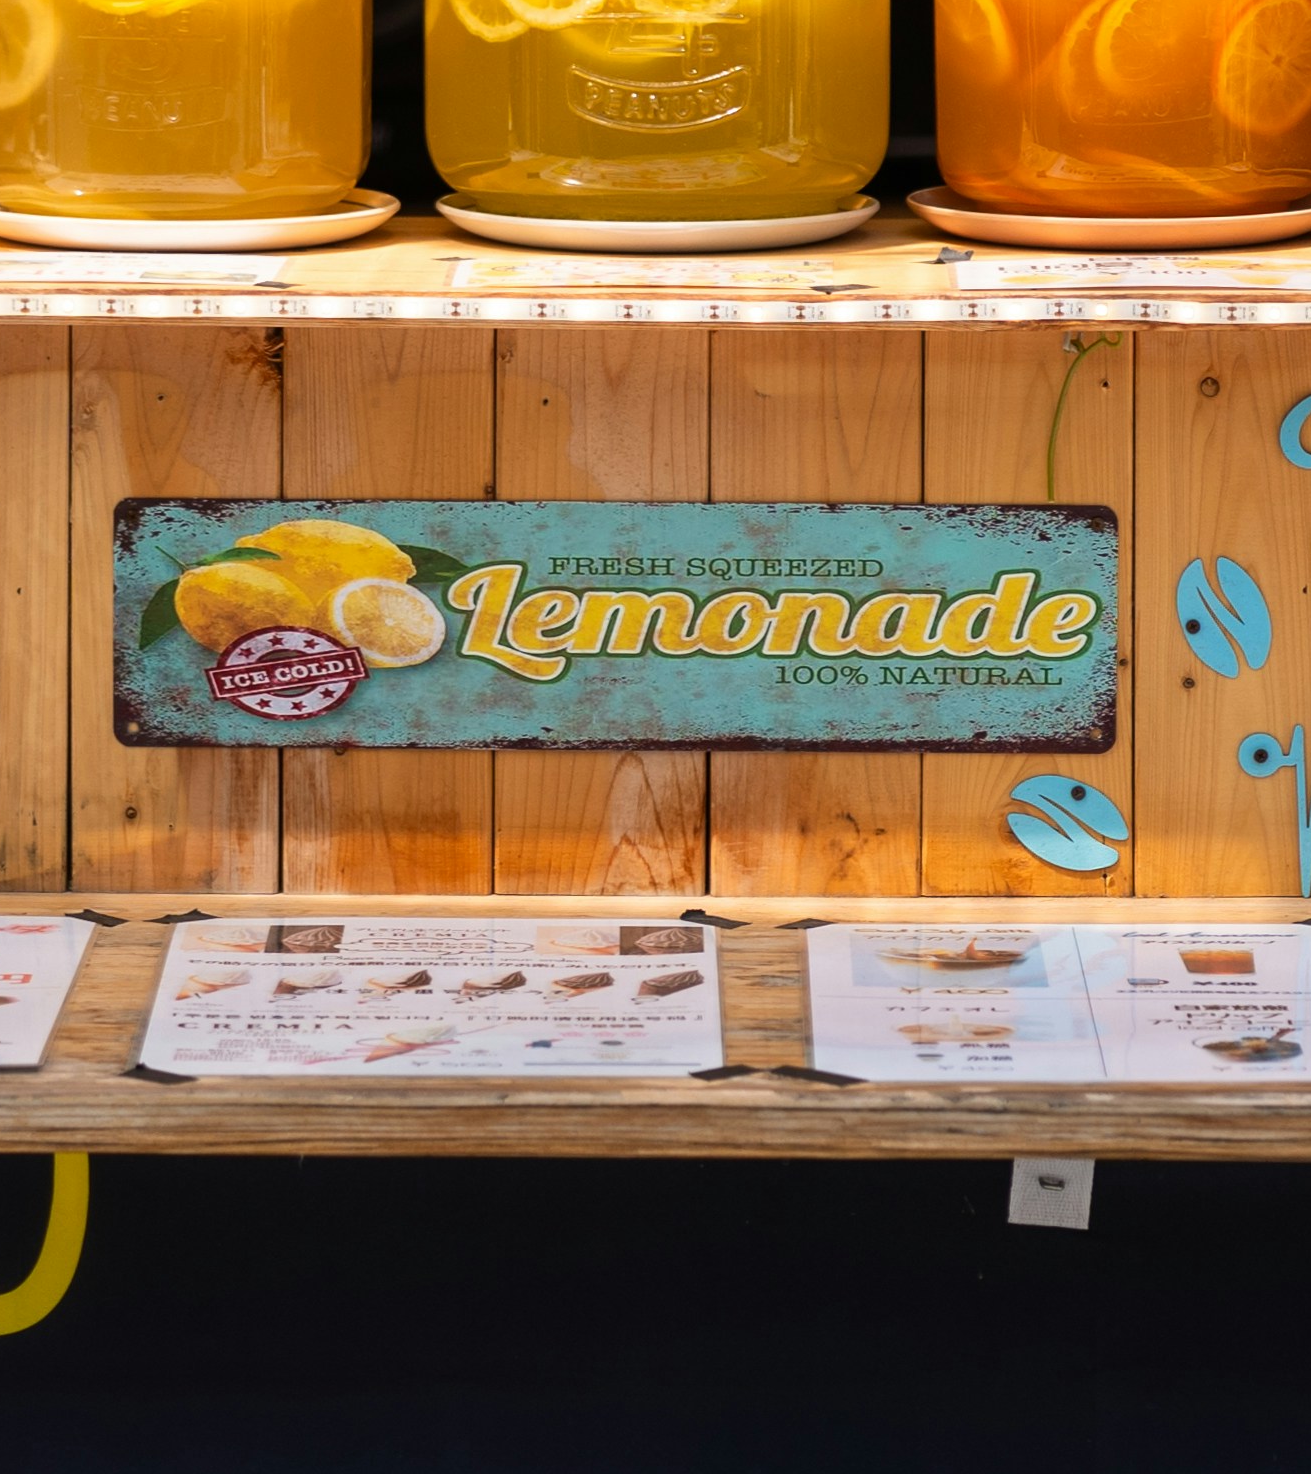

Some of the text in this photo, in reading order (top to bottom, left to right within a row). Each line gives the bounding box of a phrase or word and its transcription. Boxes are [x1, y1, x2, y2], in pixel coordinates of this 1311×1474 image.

[549, 557, 884, 579] FRESH SQUEEZED
[458, 564, 1095, 678] Lemonade
[220, 659, 355, 691] ICE COLD!
[776, 665, 1062, 686] 100% NATURAL
